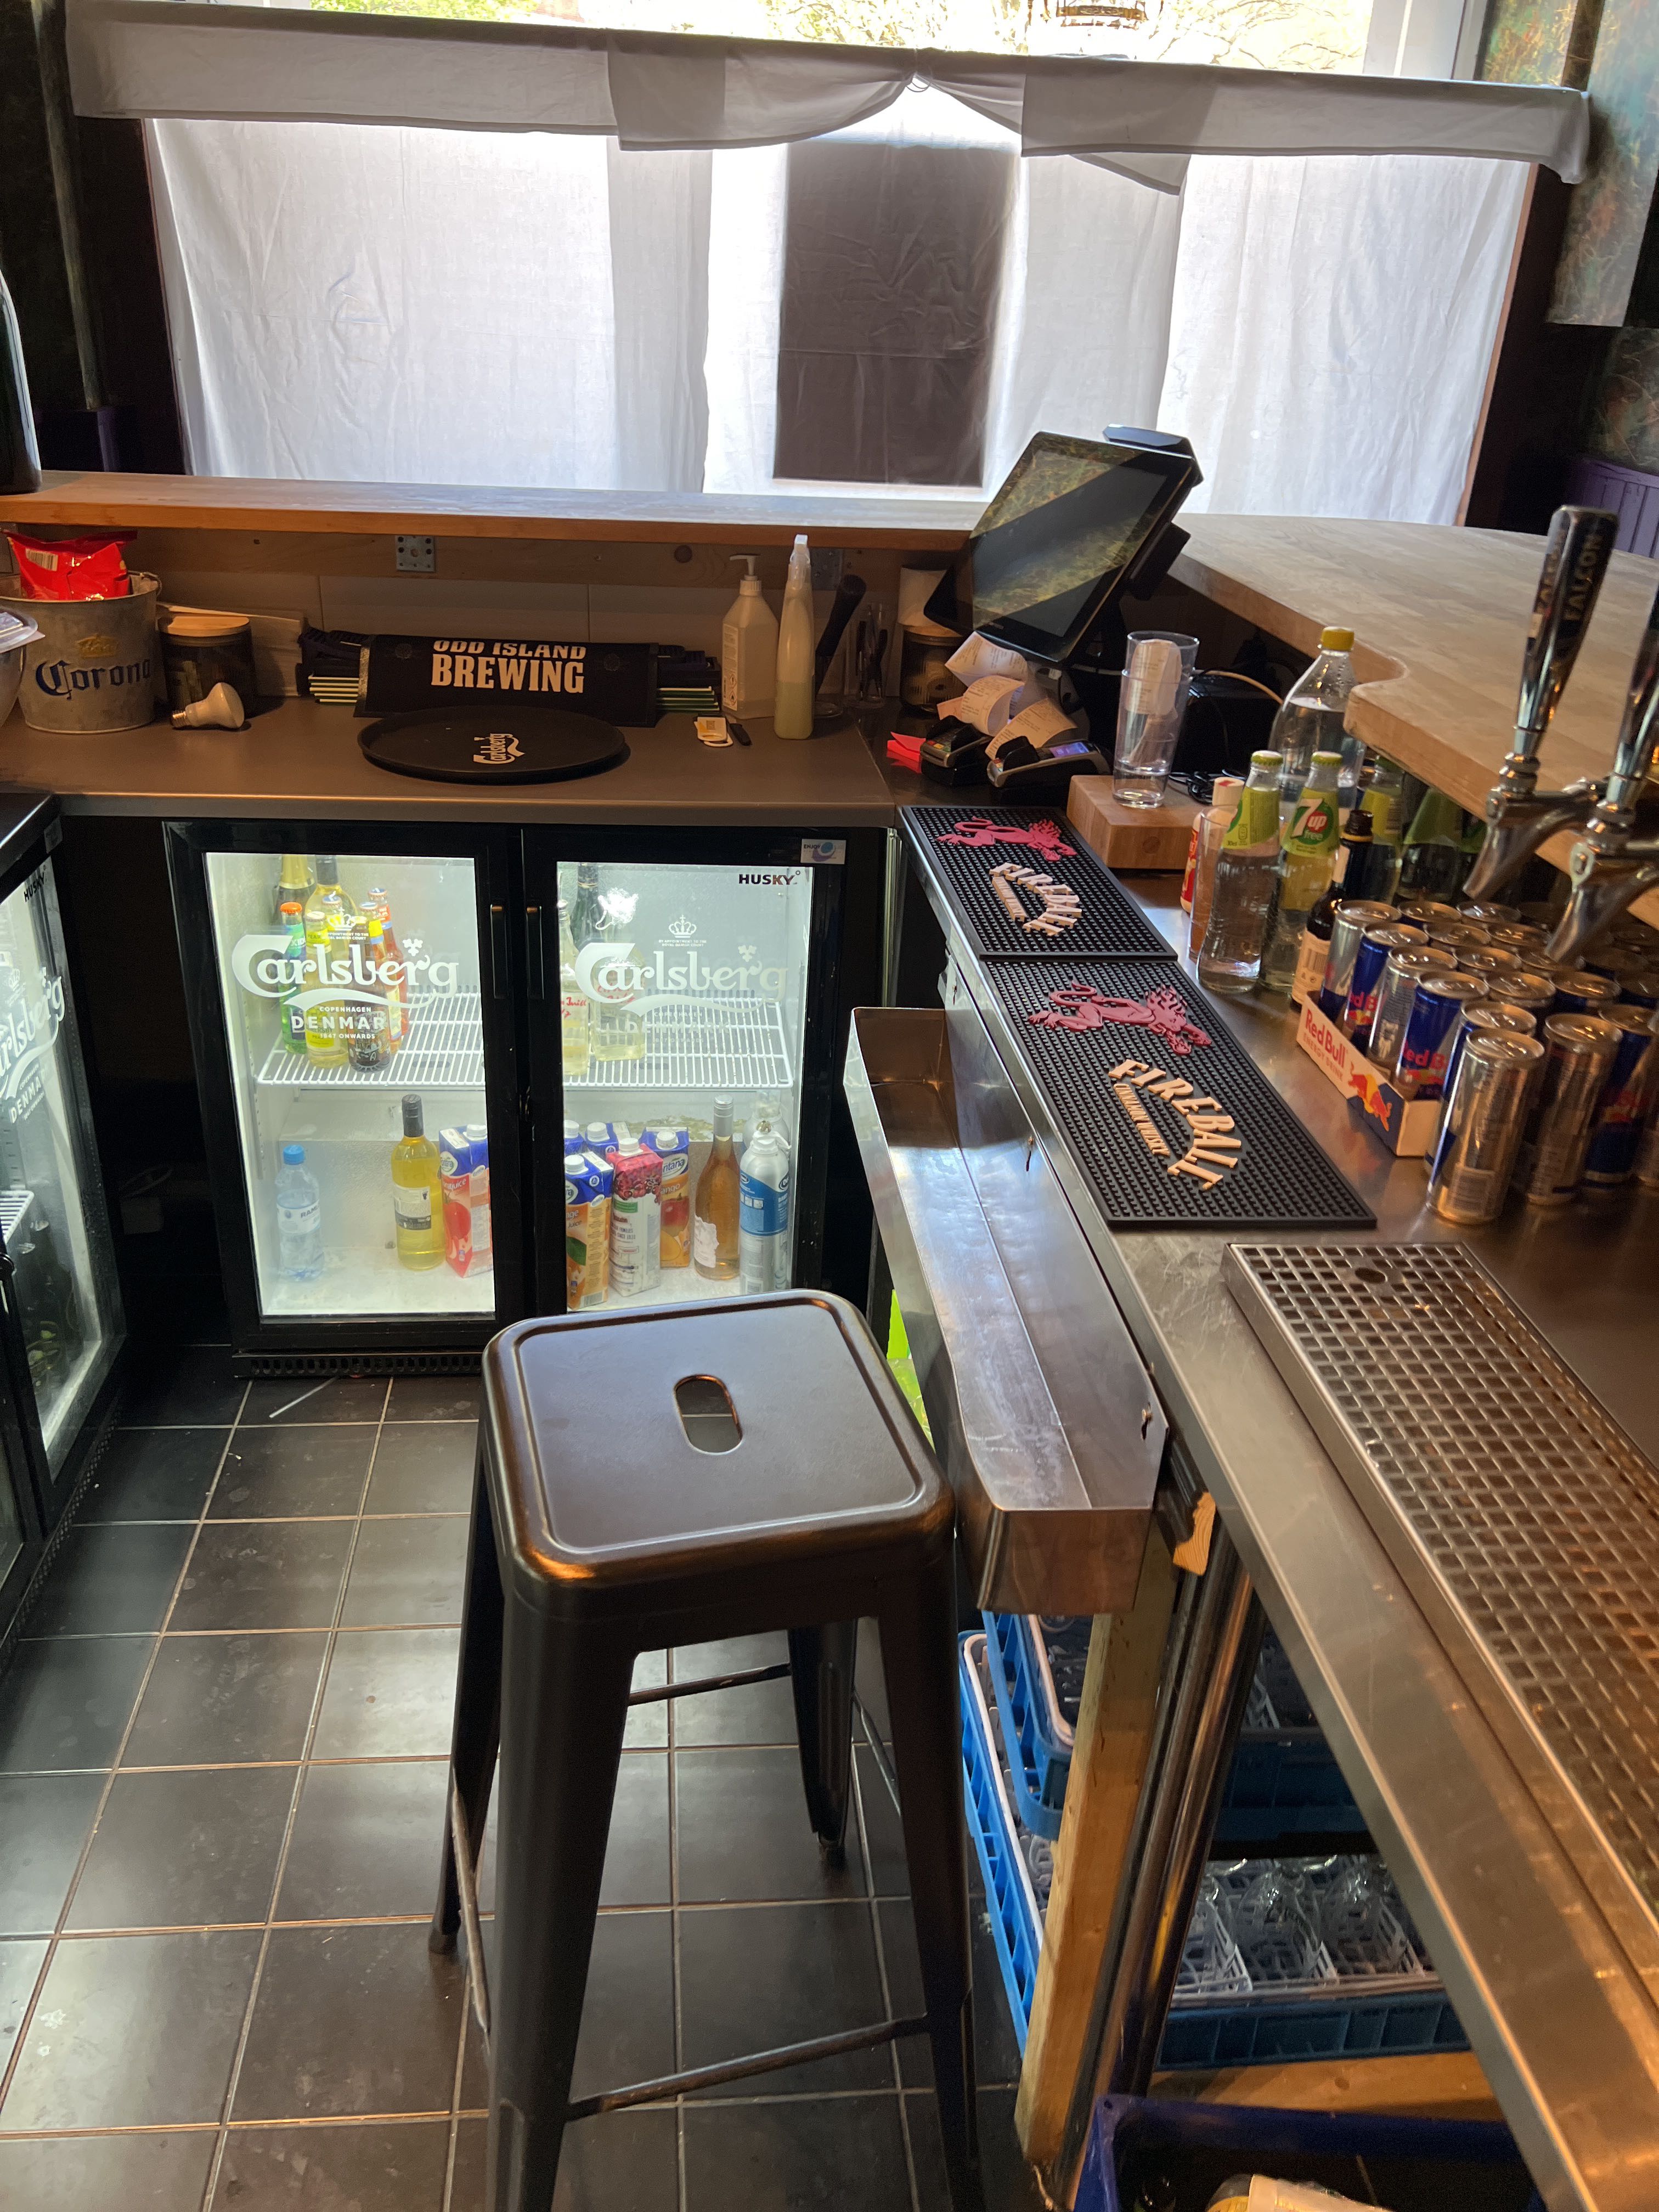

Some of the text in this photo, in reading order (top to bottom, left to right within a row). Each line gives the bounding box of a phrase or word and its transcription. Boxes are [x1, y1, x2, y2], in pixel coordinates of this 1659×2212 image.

[433, 640, 586, 659] ODD ISLAND
[36, 660, 150, 699] Corona
[431, 653, 584, 693] BREWING
[473, 733, 525, 764] Carlsberg
[1304, 829, 1323, 840] free
[24, 872, 45, 902] HUSKY
[738, 874, 794, 885] HUSKY
[989, 862, 1082, 936] FIREBALL
[232, 934, 459, 1011] Carlsberg
[575, 942, 789, 1015] Carlsberg
[1305, 1008, 1346, 1069] Red Bull
[1108, 1059, 1242, 1190] FIREBALL
[661, 1183, 681, 1194] ango
